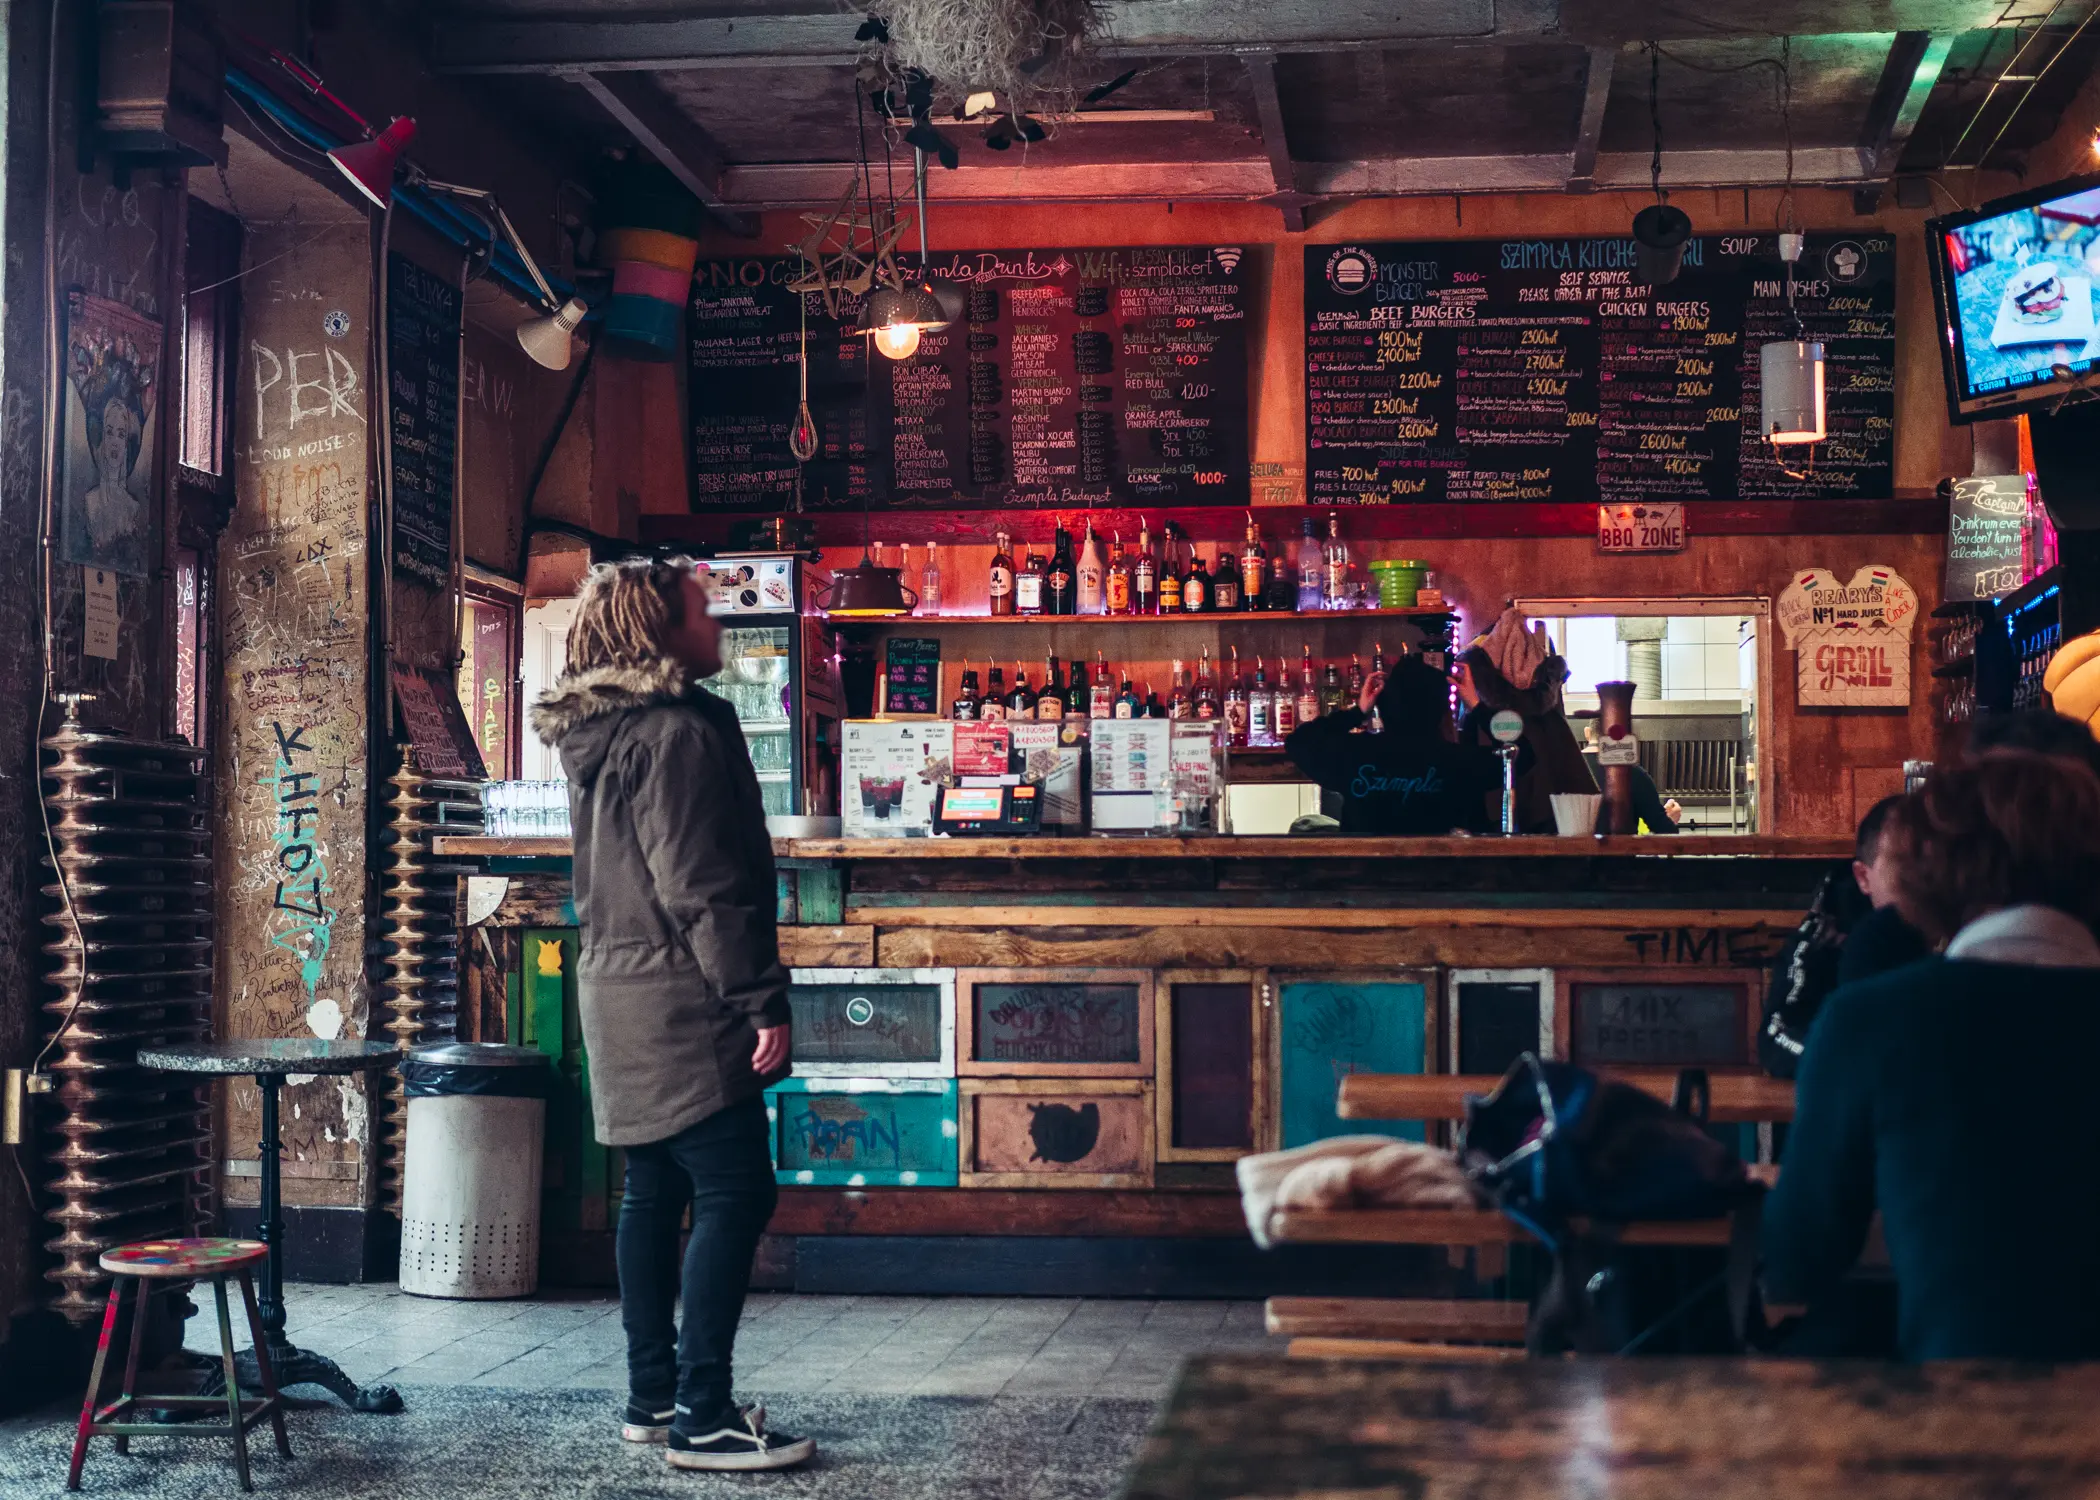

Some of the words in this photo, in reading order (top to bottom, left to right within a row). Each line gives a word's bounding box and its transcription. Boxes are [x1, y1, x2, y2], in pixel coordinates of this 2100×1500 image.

[1719, 237, 1758, 255] SOUP
[1500, 241, 1572, 269] SZIMPLA
[1579, 239, 1638, 268] KITCHE
[975, 251, 1052, 280] Drinks
[710, 260, 765, 287] NO
[1380, 261, 1440, 282] MONSTER
[1560, 272, 1585, 286] SELF
[1011, 289, 1053, 299] BEEFEATER
[1119, 289, 1140, 298] COCA
[1376, 282, 1424, 302] BURGER
[1518, 288, 1550, 302] PLEASE
[1554, 287, 1582, 301] ORDER
[1585, 287, 1598, 301] AT
[1602, 286, 1621, 300] THE
[1624, 284, 1652, 299] BAR!
[1752, 280, 1780, 297] MAIN
[1786, 280, 1830, 298] DISHES
[1121, 297, 1145, 307] KINLEY
[1122, 306, 1148, 317] KINLEY
[1174, 304, 1200, 315] FANTA
[1370, 305, 1406, 321] BEEF
[1410, 304, 1477, 320] BURGERS
[1598, 301, 1648, 317] CHICKEN
[1655, 301, 1711, 317] BURGERS
[1014, 324, 1048, 335] WHISKY
[1319, 320, 1340, 331] BASIC
[1343, 319, 1386, 330] INGREDIENTS
[1388, 319, 1403, 329] BEEF
[920, 336, 949, 347] BLANCO
[1012, 335, 1029, 344] JACK
[1122, 332, 1157, 345] Bottled
[1159, 331, 1190, 344] Mineral
[1193, 331, 1220, 344] Water
[921, 345, 941, 356] GOLD
[1123, 344, 1150, 355] STILL
[1153, 346, 1163, 354] or
[1165, 342, 1214, 353] SPARKLING
[1011, 352, 1045, 361] JAMESON
[892, 365, 909, 376] RON
[912, 364, 942, 375] CUBAY
[1011, 361, 1024, 369] JIM
[1025, 360, 1045, 369] BEAM
[1125, 367, 1155, 380] Energy
[1156, 367, 1184, 378] Drink
[892, 382, 920, 392] CAPTAIN
[922, 380, 952, 391] MORGAN
[1125, 379, 1143, 390] RED
[1145, 378, 1165, 389] BULL
[894, 390, 919, 399] STROH
[921, 390, 933, 399] 80
[1011, 388, 1041, 398] MARTINI
[1043, 387, 1072, 397] BIANCO
[1011, 397, 1043, 407] MARTINI
[1049, 396, 1064, 406] DRY
[899, 405, 936, 418] BRANDY
[1311, 401, 1331, 414] BBQ
[1333, 401, 1365, 413] BURGER
[894, 416, 925, 426] METAXA
[1011, 414, 1051, 423] ABSINTHE
[1011, 423, 1045, 433] UNICUM
[894, 434, 925, 443] AVERNA
[1047, 432, 1058, 441] XO
[1049, 440, 1077, 449] AMARETTO
[894, 449, 945, 461] BECHEROVKA
[1013, 448, 1040, 458] MALIBU
[1419, 446, 1470, 460] DISHES
[894, 460, 929, 470] CAMPARI
[1014, 457, 1049, 467] SAMBUCA
[1377, 459, 1397, 468] ONLY
[1399, 459, 1412, 468] FOR
[1413, 459, 1428, 468] THE
[1014, 465, 1048, 475] SOUTHERN
[1048, 464, 1077, 475] COMFORT
[1127, 462, 1178, 475] Lemonades
[895, 470, 932, 480] FIREBALL
[1127, 474, 1162, 485] CLASSIC
[1314, 470, 1340, 480] FRIES
[1446, 471, 1470, 480] SWEET
[1473, 471, 1498, 480] POTATO
[1500, 471, 1521, 480] FRIES
[1314, 483, 1340, 492] FRIES
[1350, 483, 1391, 492] COLESLAW
[1446, 480, 1485, 490] COLESLAW
[1003, 486, 1060, 508] Szimpla
[1060, 485, 1112, 508] Budapest
[1446, 489, 1469, 500] ONION
[1469, 489, 1490, 500] RINGS
[1312, 496, 1334, 506] CURLY
[1336, 495, 1358, 505] FRIES
[1952, 513, 1980, 531] Drink
[1980, 519, 1998, 529] rum
[1999, 520, 2021, 530] ever
[1602, 528, 1633, 547] BBQ
[1640, 527, 1681, 546] ZONE
[1952, 532, 1970, 545] You
[1970, 531, 1992, 544] don't
[1994, 531, 2012, 544] turn
[1811, 585, 1883, 606] BEARY'S
[1836, 609, 1859, 619] HARD
[1860, 608, 1885, 618] JUICE
[1885, 600, 1915, 623] CIDER
[250, 976, 302, 1016] Kentucky
